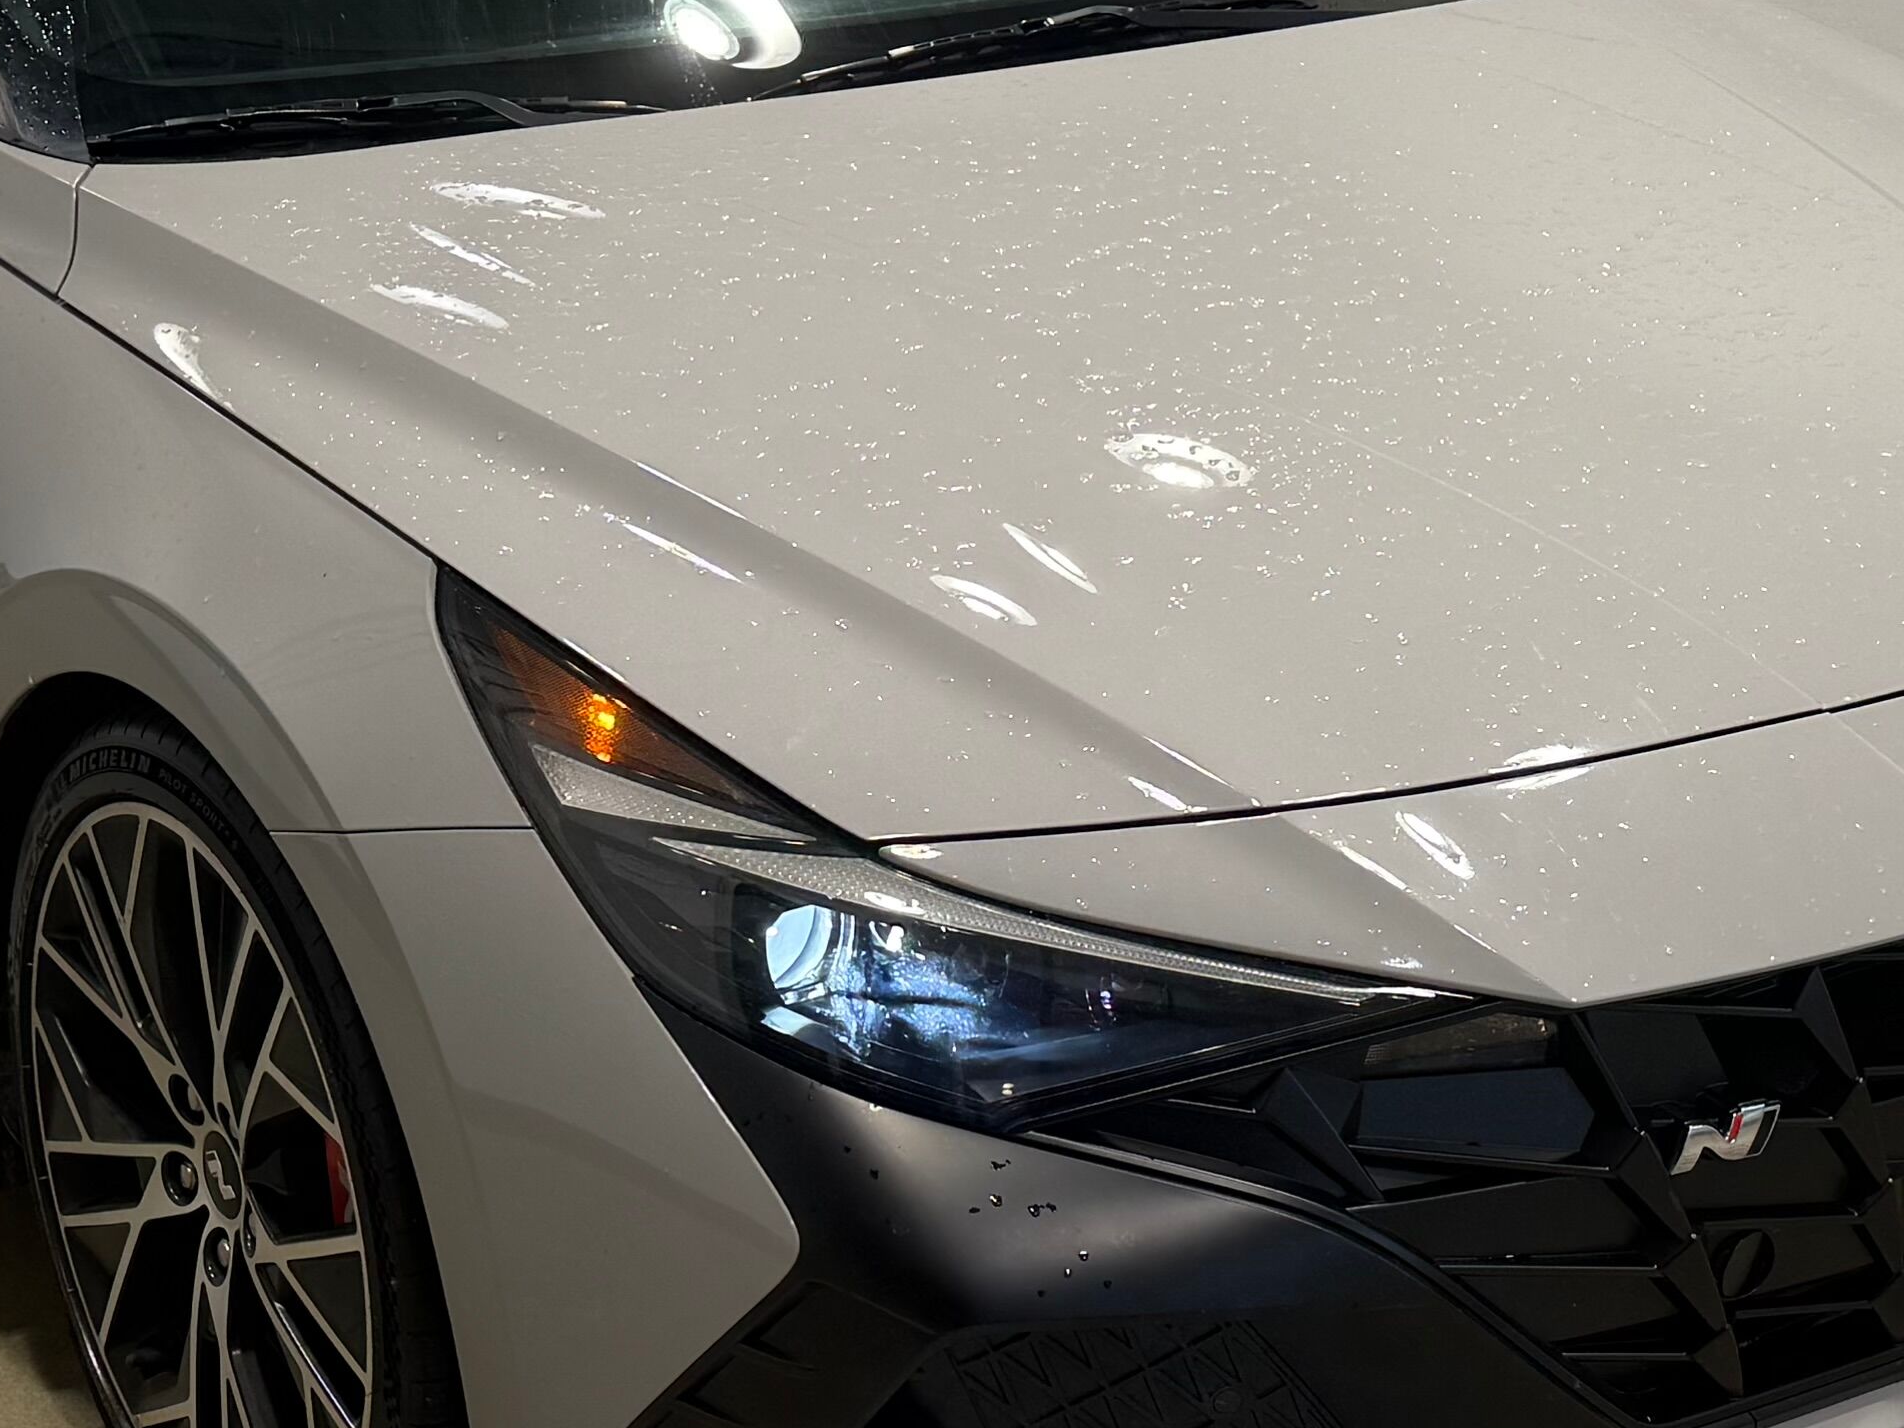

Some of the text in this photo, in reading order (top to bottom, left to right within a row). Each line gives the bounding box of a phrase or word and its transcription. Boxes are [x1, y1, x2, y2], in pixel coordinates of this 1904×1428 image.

[69, 746, 152, 781] MICHELIN
[158, 768, 188, 795] PILOT
[1670, 1100, 1781, 1176] N
